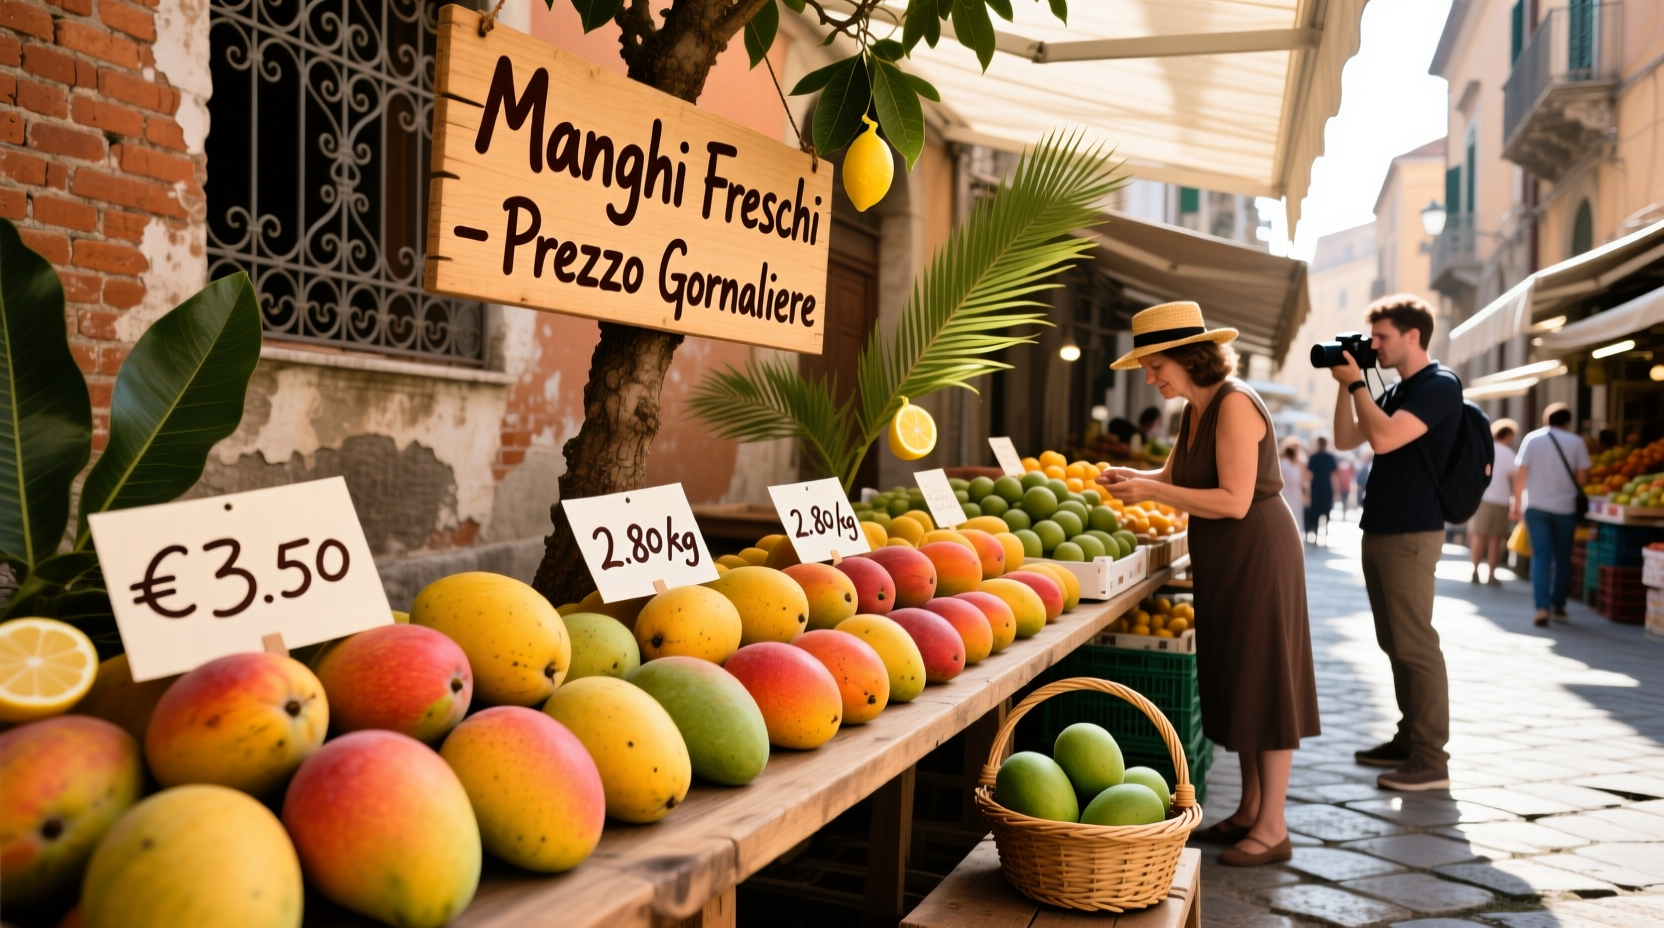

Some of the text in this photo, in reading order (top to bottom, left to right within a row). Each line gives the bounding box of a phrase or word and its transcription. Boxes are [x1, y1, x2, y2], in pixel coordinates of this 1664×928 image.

[475, 55, 822, 246] Manghi Freschi
[502, 195, 644, 294] Prezzo
[659, 239, 817, 328] Gornaliere
[129, 537, 350, 619] €3.50
